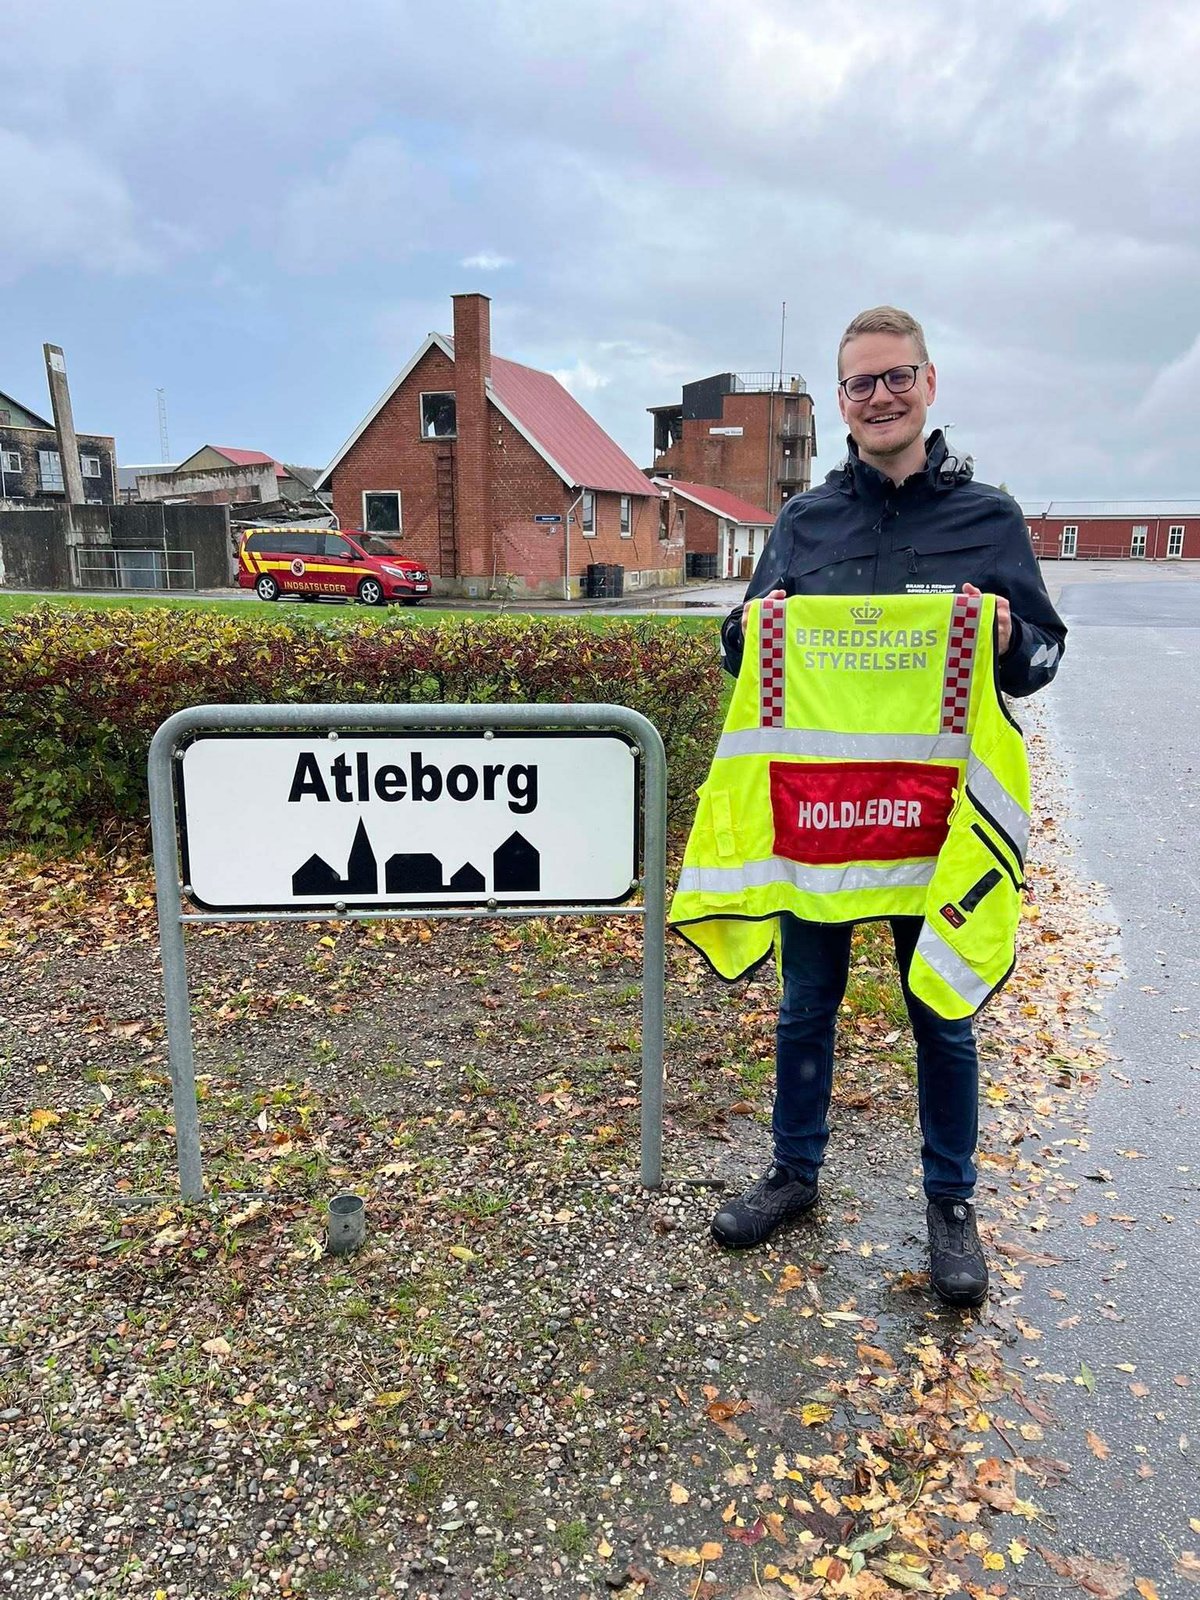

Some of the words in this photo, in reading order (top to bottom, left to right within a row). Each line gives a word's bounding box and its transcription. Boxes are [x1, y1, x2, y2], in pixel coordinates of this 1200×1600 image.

[284, 581, 346, 592] INDSATSLEDER
[796, 628, 938, 647] BEREDSKABS
[804, 651, 928, 670] STYRELSEN
[289, 752, 538, 814] Atleborg
[798, 799, 922, 829] HOLDLEDER
